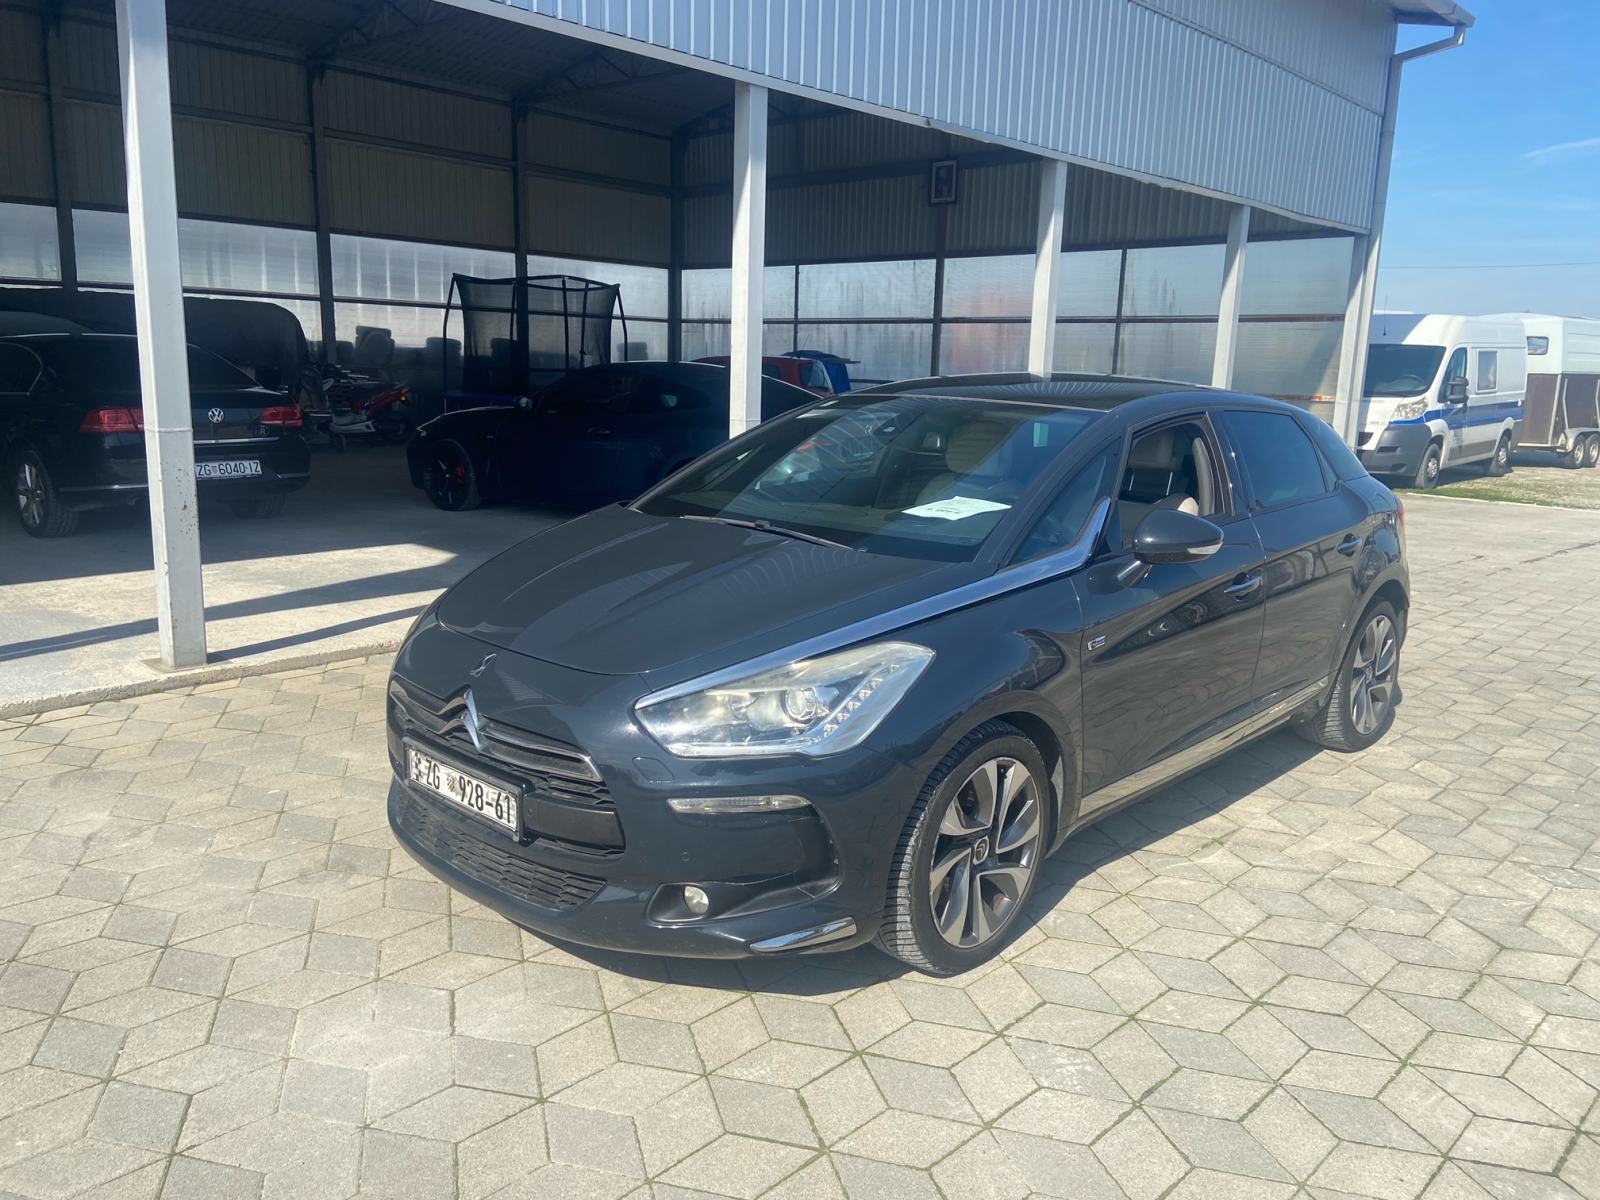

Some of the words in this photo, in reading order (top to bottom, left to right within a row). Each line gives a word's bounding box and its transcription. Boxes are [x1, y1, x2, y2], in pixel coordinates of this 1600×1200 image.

[196, 464, 212, 476] ZG
[425, 758, 441, 790] ZG
[458, 776, 512, 824] 928-61
